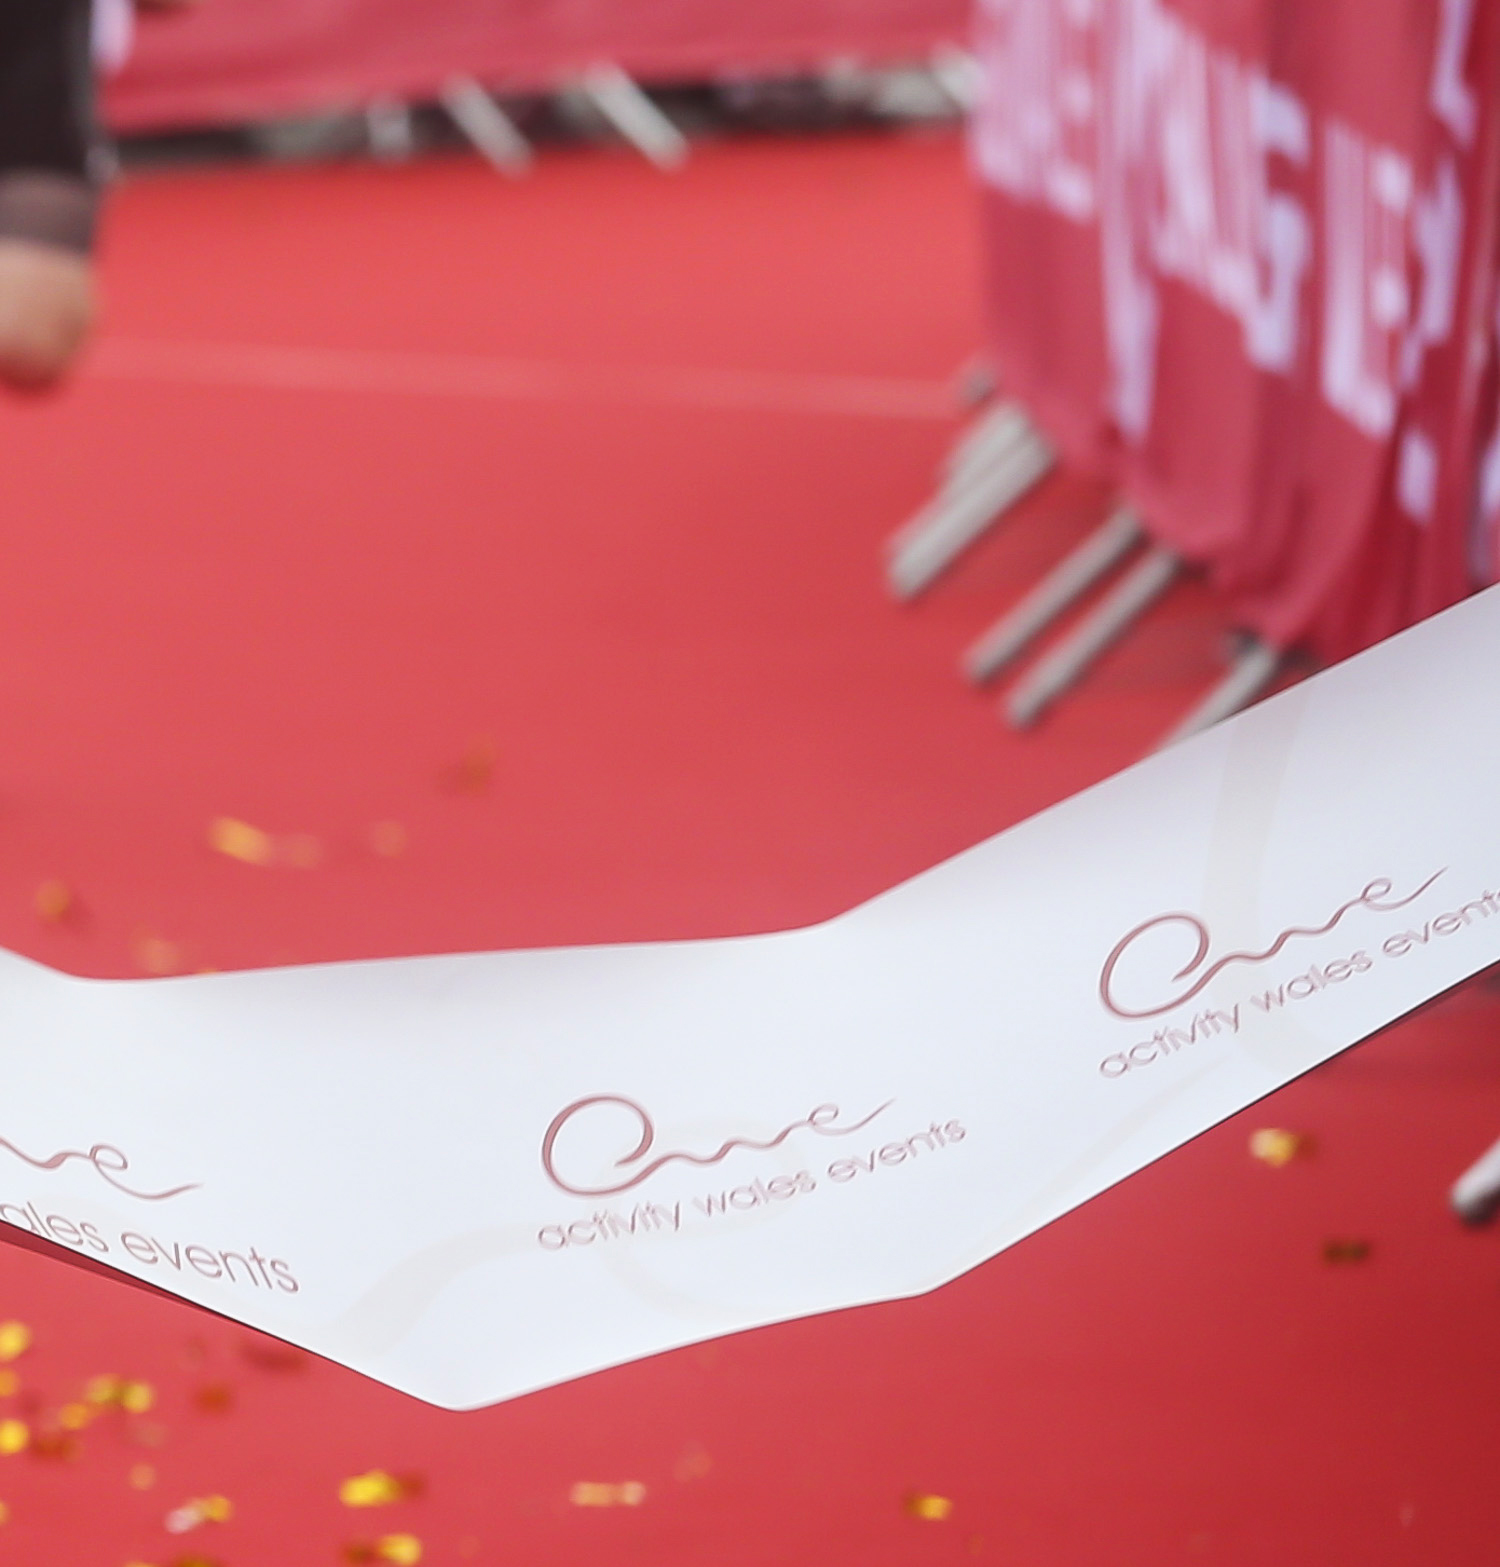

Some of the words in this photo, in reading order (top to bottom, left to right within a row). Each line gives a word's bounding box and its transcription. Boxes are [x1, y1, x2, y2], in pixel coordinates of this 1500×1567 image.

[1098, 1002, 1241, 1079] activity
[1249, 949, 1374, 1014] wales
[1381, 887, 1500, 959] event
[536, 1196, 683, 1253] activity
[693, 1167, 818, 1220] wales
[826, 1115, 968, 1189] events
[120, 1227, 301, 1296] events
